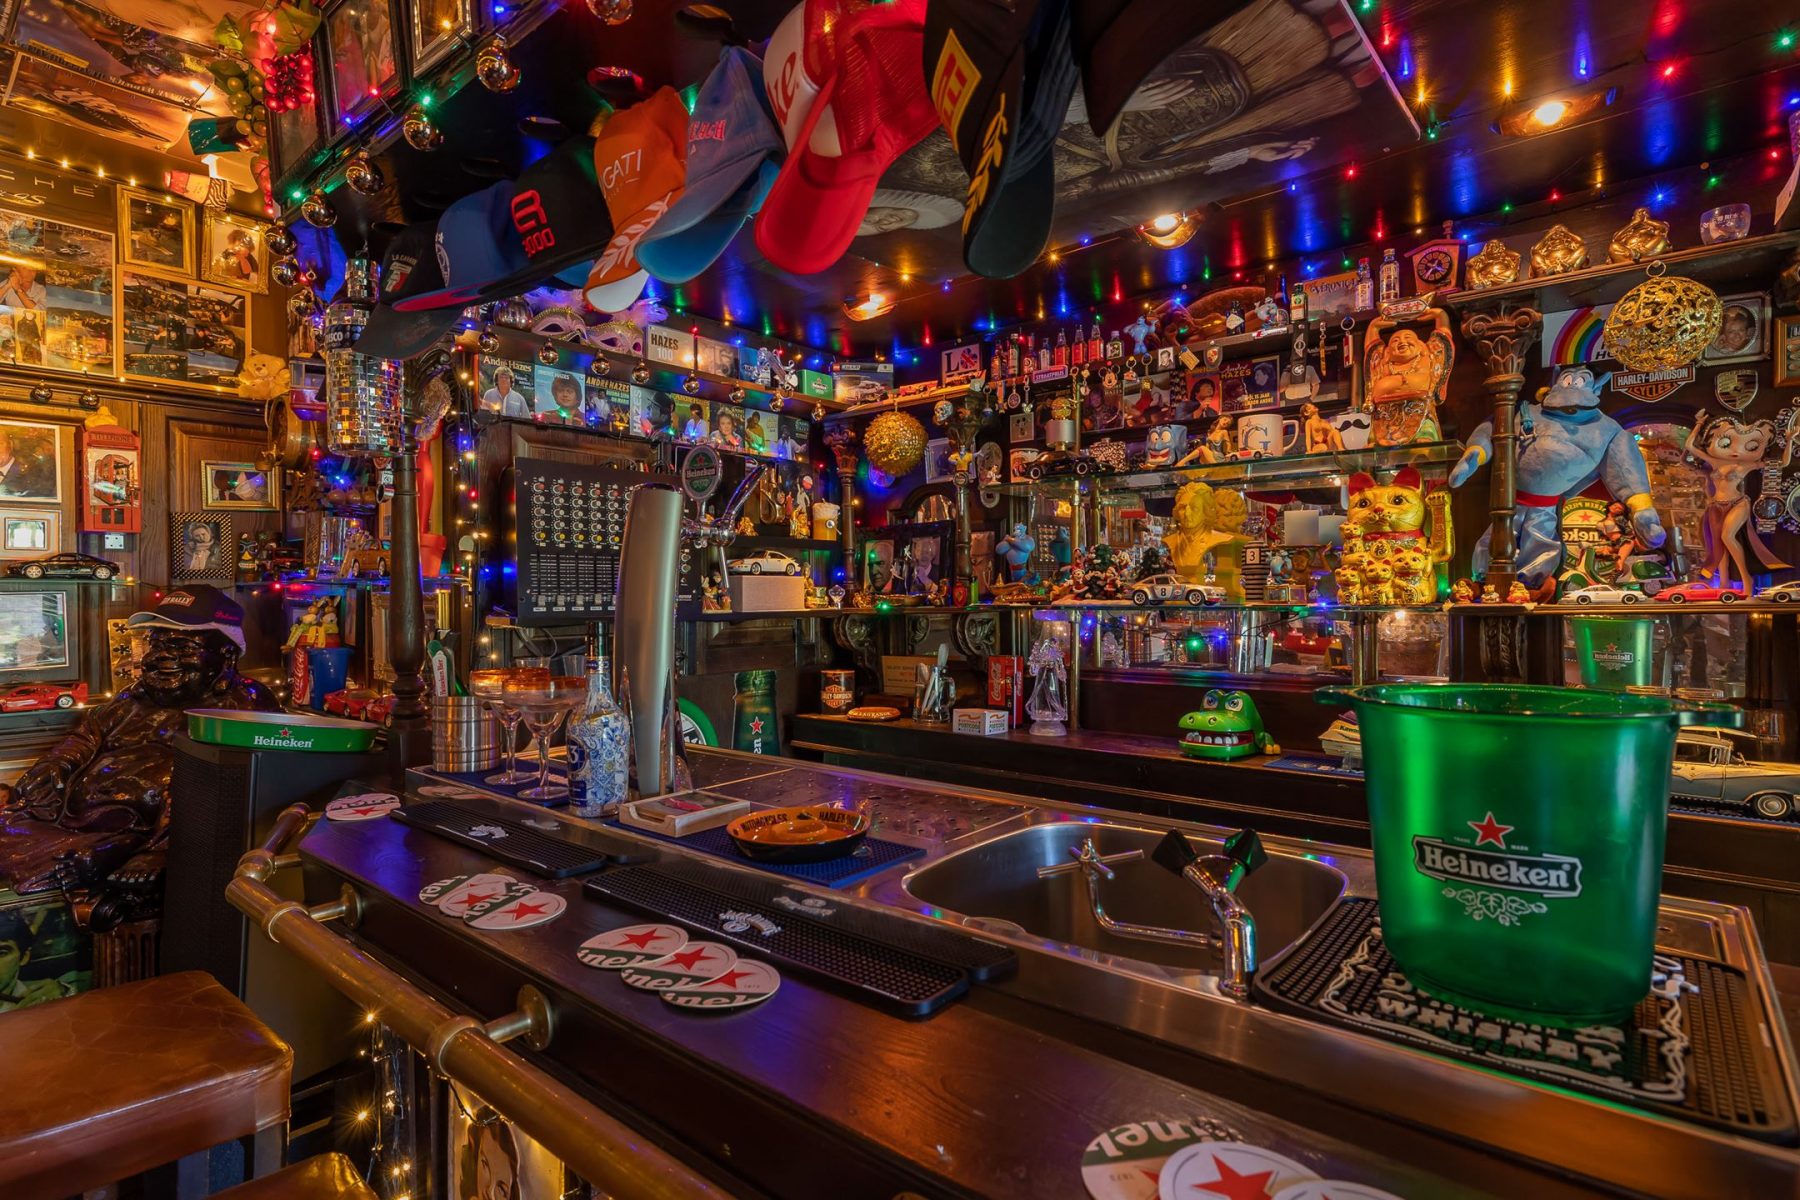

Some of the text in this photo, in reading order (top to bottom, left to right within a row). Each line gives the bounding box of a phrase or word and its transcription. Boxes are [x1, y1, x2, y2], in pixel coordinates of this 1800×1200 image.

[650, 333, 679, 350] HAZES
[508, 360, 532, 372] Hazes
[1617, 367, 1689, 387] HARLEY-DAVIDSON
[608, 381, 630, 392] HAZES
[632, 390, 642, 433] HAZES
[1249, 551, 1257, 562] 3
[1160, 587, 1167, 597] 8
[253, 735, 313, 749] Heineken
[1422, 844, 1570, 888] Heineken
[1376, 996, 1623, 1071] WHISKEY
